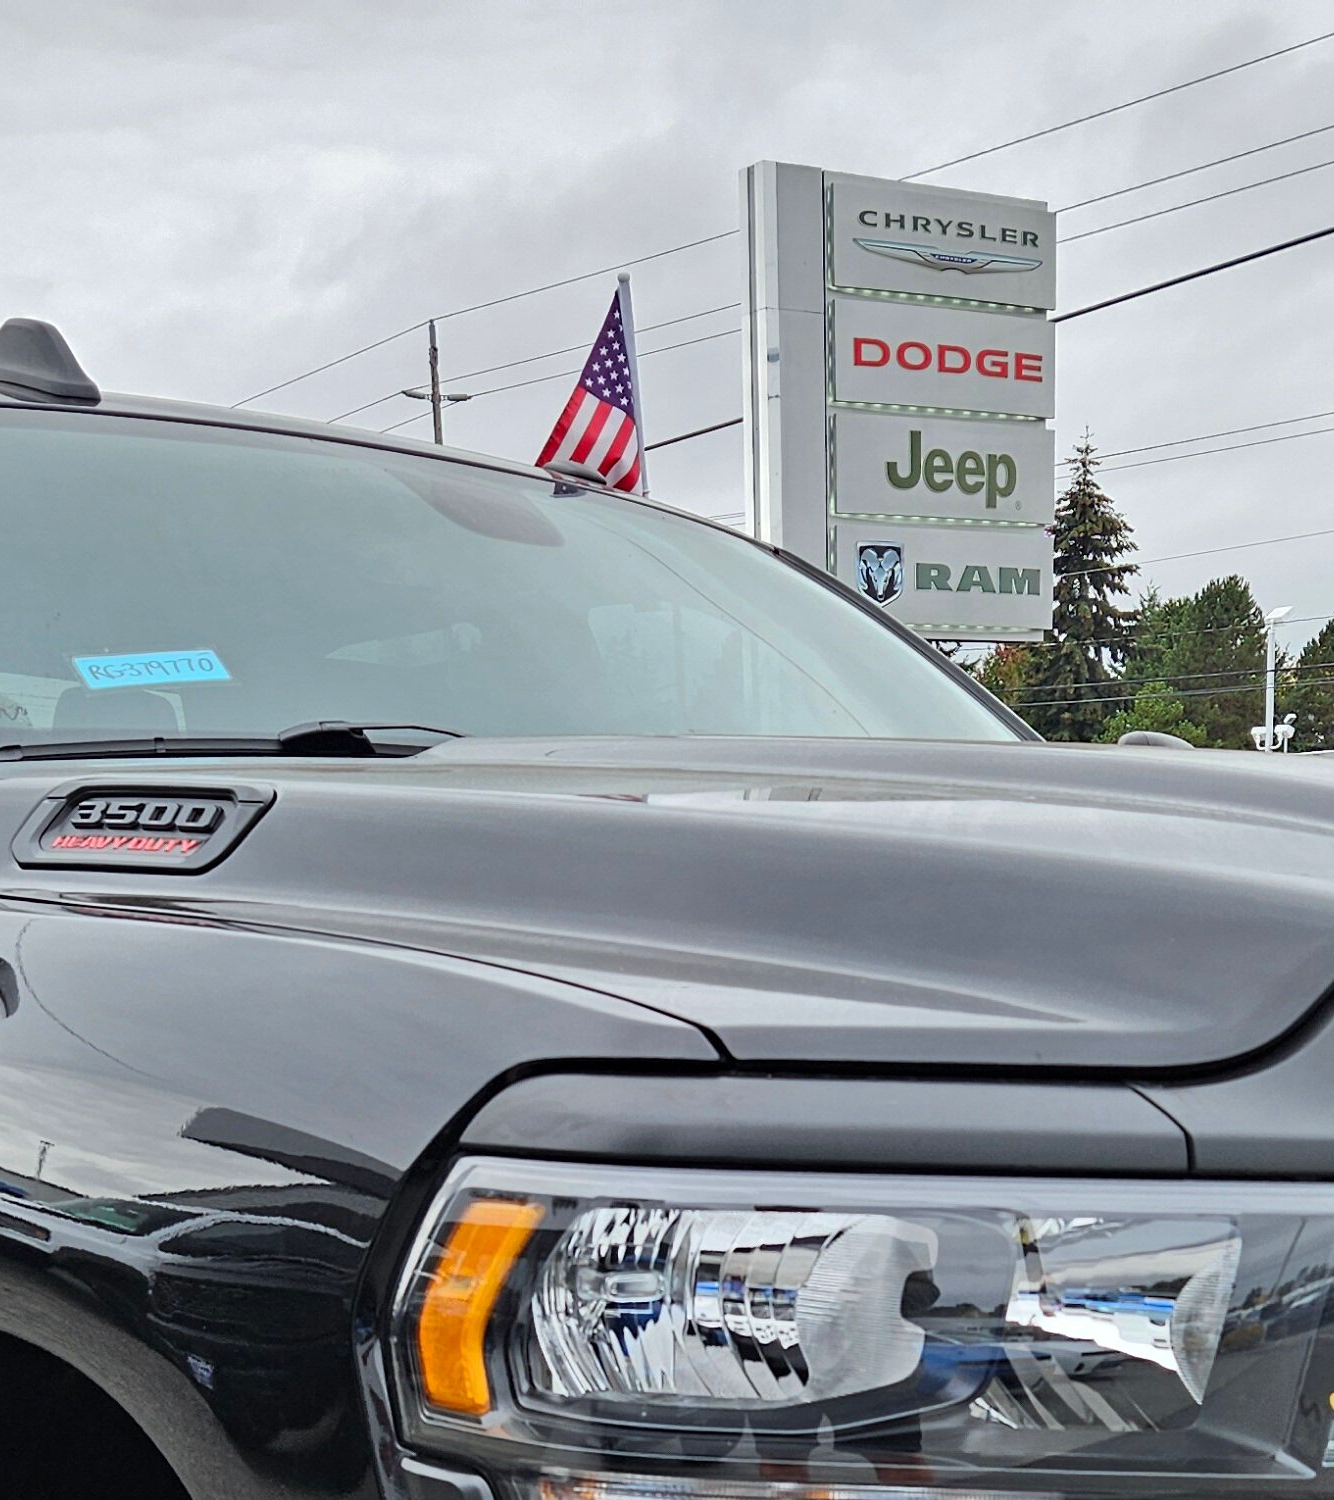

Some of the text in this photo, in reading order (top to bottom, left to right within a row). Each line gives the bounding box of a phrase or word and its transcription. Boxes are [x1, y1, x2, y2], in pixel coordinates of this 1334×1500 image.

[858, 210, 1040, 248] CHRYSLER
[853, 337, 1043, 382] DODGE
[886, 430, 1017, 509] Jeep
[915, 562, 1041, 596] RAM
[71, 801, 225, 833] 3500
[52, 835, 202, 853] HEAVY DUTY
